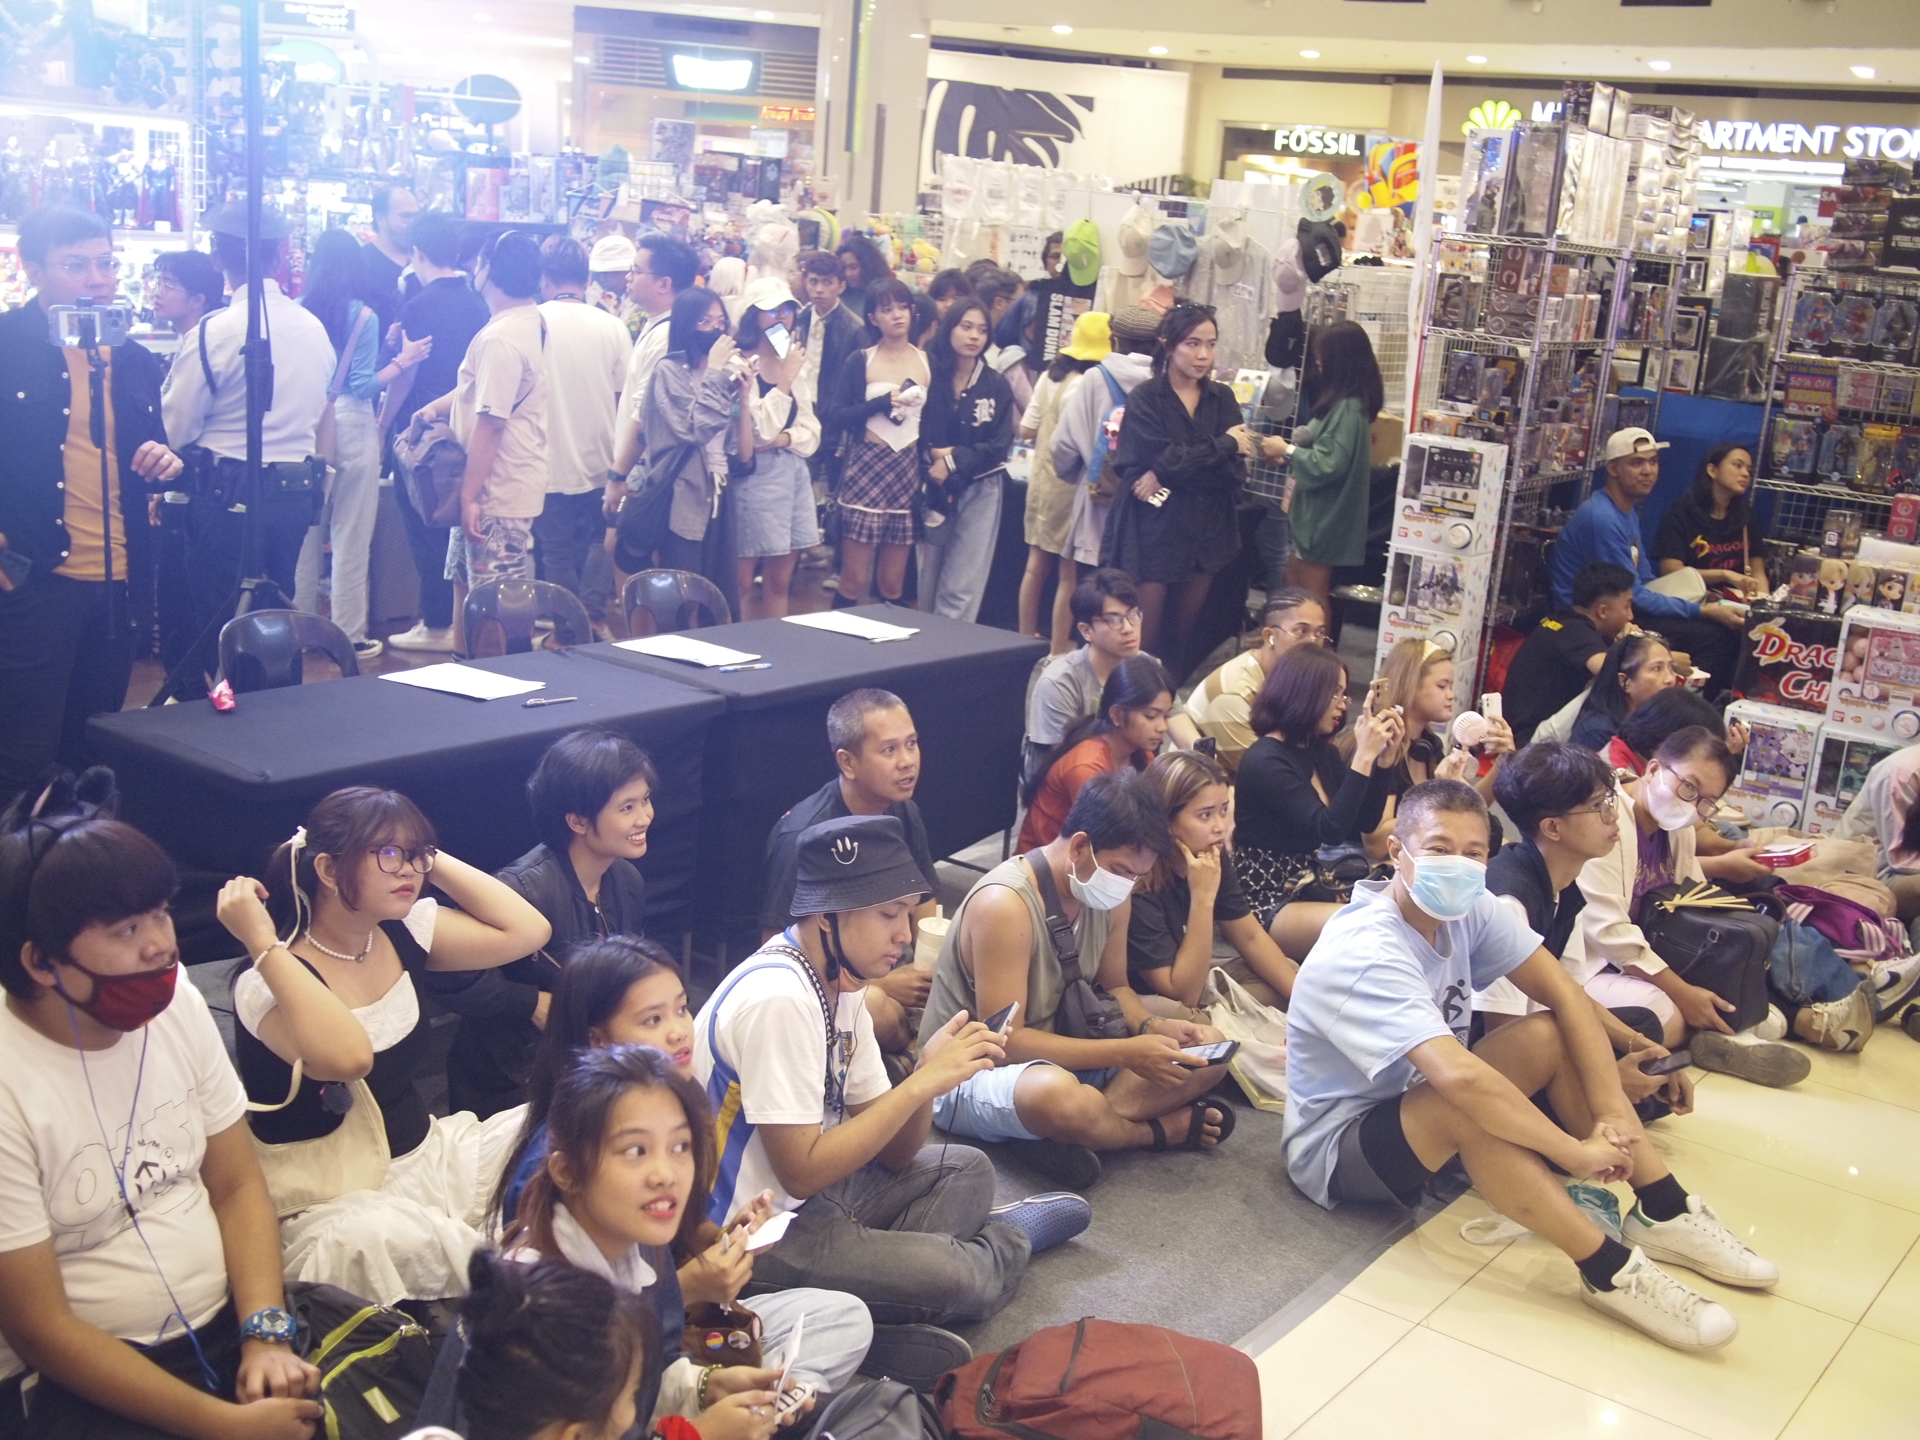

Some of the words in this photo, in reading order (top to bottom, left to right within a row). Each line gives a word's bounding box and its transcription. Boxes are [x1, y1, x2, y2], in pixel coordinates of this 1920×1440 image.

[1274, 129, 1360, 156] FOSSIL
[1046, 292, 1064, 329] SLAM
[1042, 327, 1060, 361] DUNK
[1790, 376, 1812, 387] 50%
[1814, 379, 1832, 389] OFF
